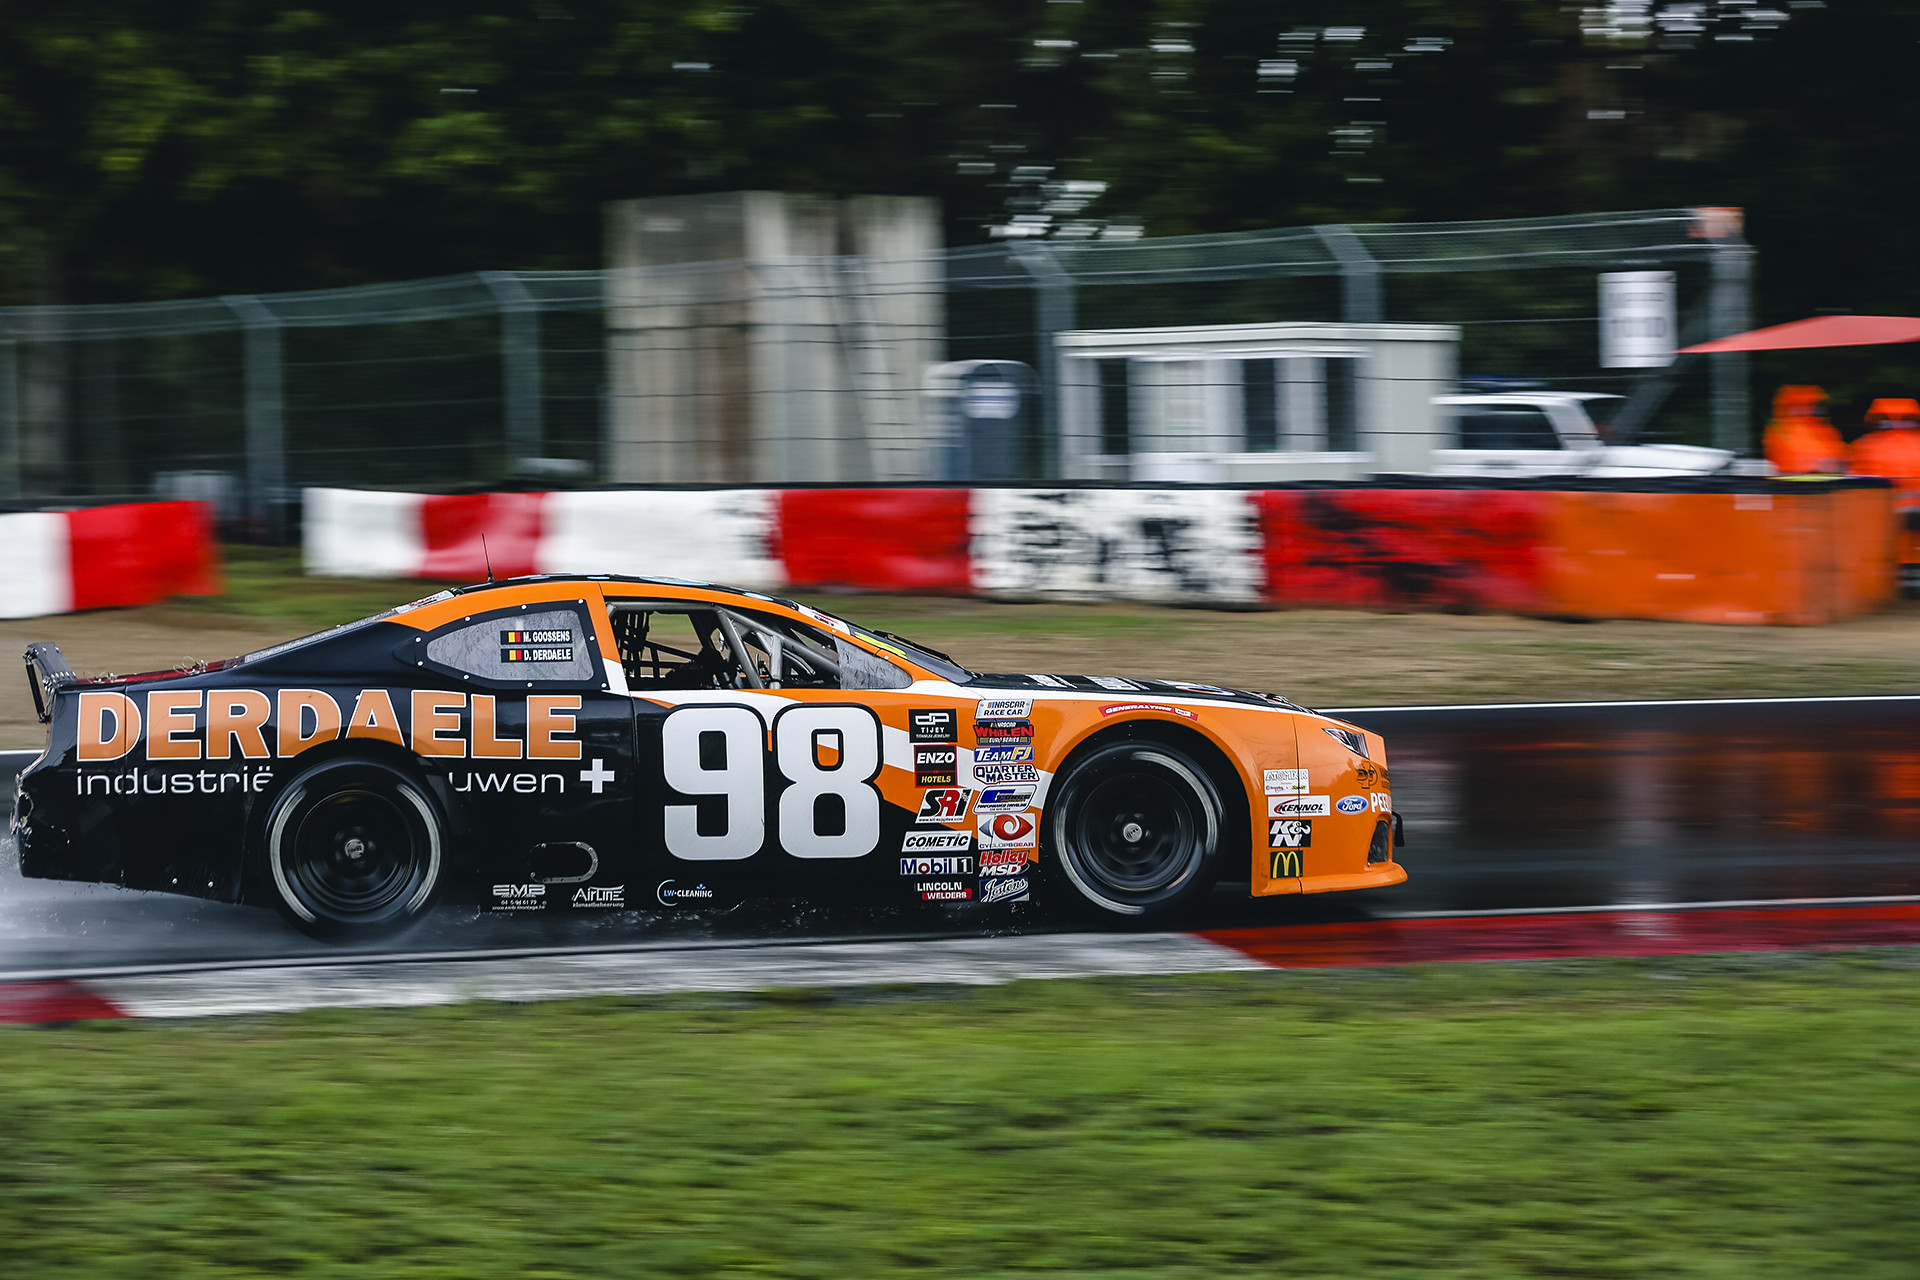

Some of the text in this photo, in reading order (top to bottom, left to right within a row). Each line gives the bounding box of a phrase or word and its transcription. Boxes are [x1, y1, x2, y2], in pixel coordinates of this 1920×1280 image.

[523, 631, 570, 642] M. GOOSSENS
[523, 649, 571, 661] D. DERDAELE
[76, 689, 583, 762] DERDAELE
[974, 725, 1034, 737] WHELEN
[917, 752, 955, 764] ENZO
[975, 765, 1033, 778] QUARTER
[986, 772, 1036, 782] MASTER
[662, 707, 880, 860] 98
[921, 775, 951, 783] HOTELS
[920, 789, 972, 816] SRI
[1342, 798, 1363, 811] Ford
[905, 836, 969, 847] COMETIC
[979, 850, 1029, 866] Holley
[901, 858, 952, 874] Mobil
[979, 865, 1022, 877] MSD
[917, 882, 962, 891] LINCOLN
